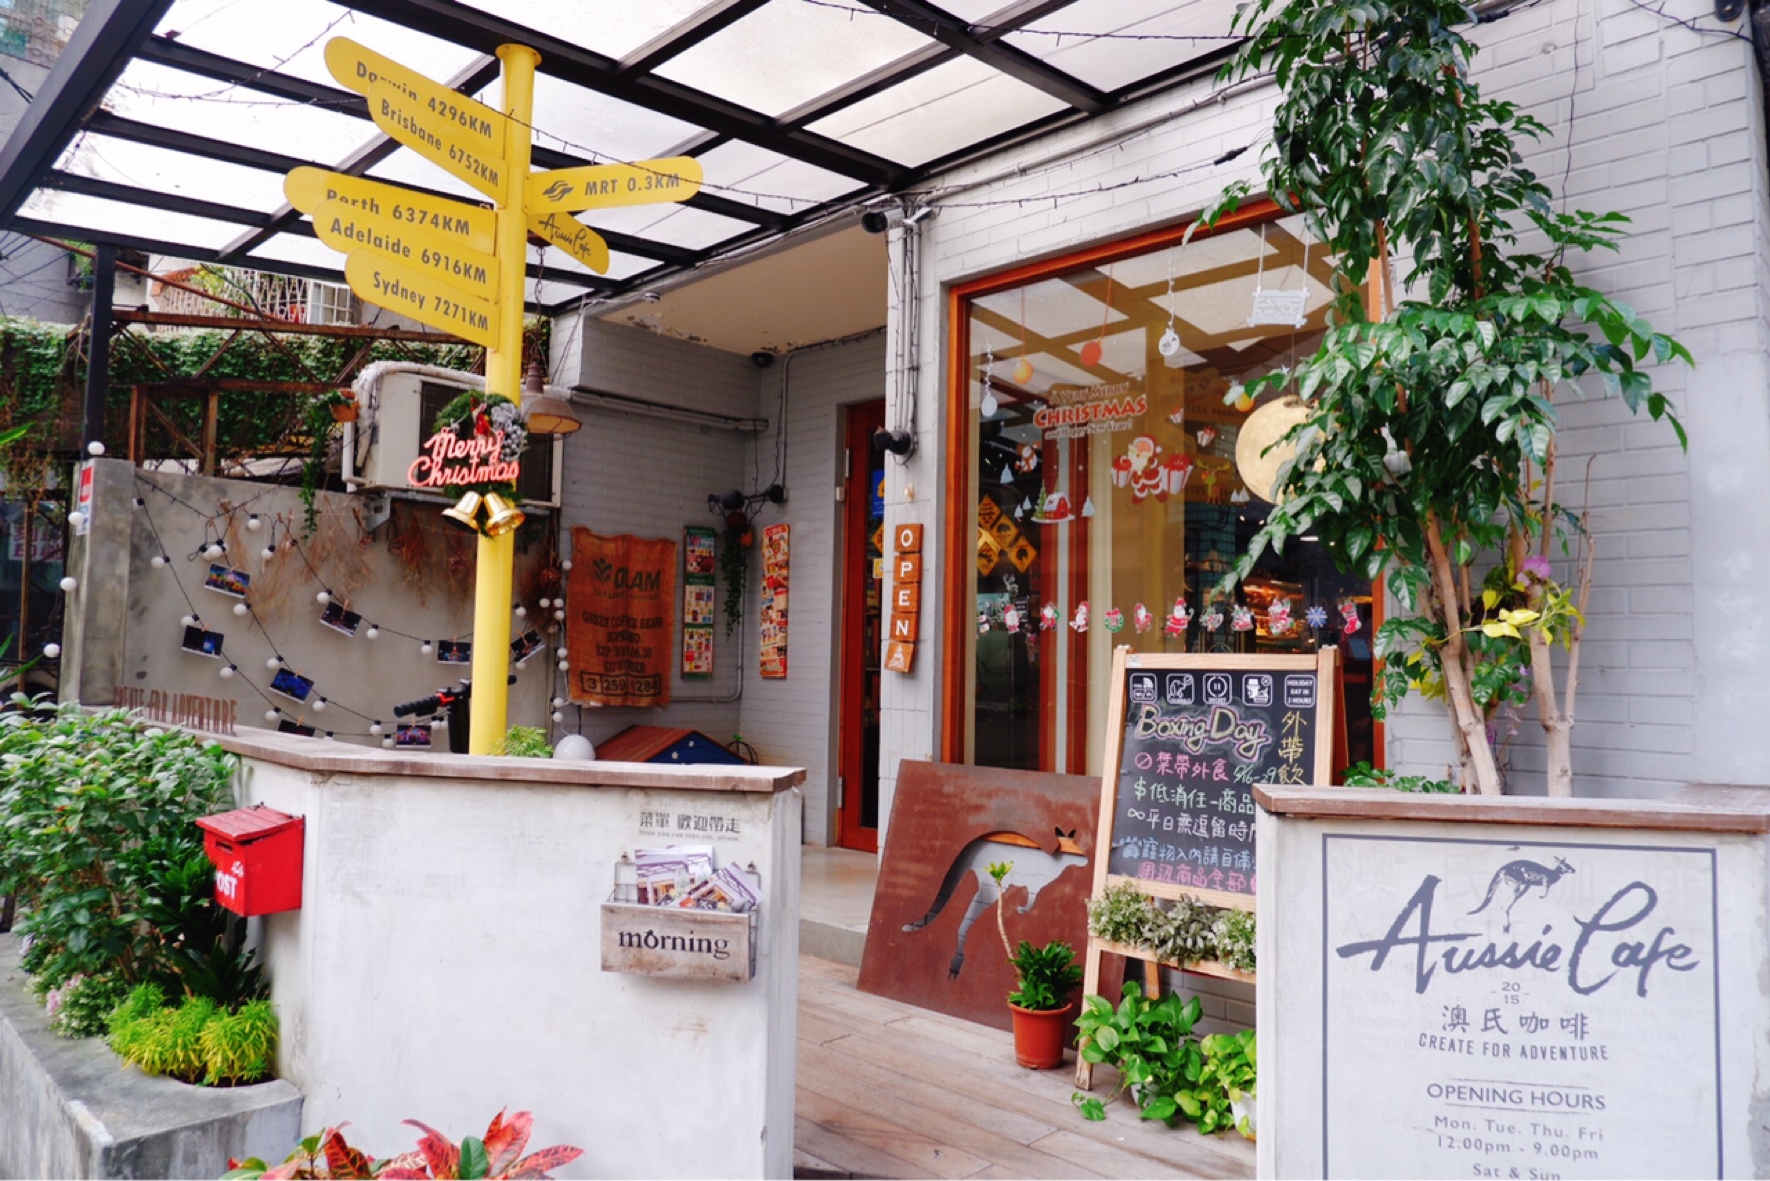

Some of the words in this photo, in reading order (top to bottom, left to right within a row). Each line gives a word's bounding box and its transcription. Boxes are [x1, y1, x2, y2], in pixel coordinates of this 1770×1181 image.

[356, 61, 418, 101] Dain
[428, 97, 493, 139] 4296KM
[381, 98, 442, 150] Brisbane
[449, 144, 499, 187] 6752KM
[584, 179, 618, 196] MRT
[627, 173, 680, 192] 0.3KM
[392, 204, 471, 236] 6374KM
[330, 217, 411, 258] Adelaide
[421, 248, 487, 285] 6916KM
[373, 271, 426, 310] Sydney
[434, 296, 489, 331] 7271KM
[1033, 393, 1148, 428] CHRISTMAS
[423, 426, 507, 463] Merry
[407, 455, 520, 488] Christmas
[614, 566, 662, 592] OLAM
[587, 677, 597, 690] 3
[603, 678, 627, 691] 259
[1135, 703, 1208, 755] Boxing
[1210, 705, 1272, 762] Day
[676, 813, 741, 834] 歡迎帶走
[1146, 808, 1257, 842] 平日無逗留時
[215, 870, 238, 900] OST
[618, 928, 731, 960] morning
[1336, 874, 1562, 995] Aussie
[1567, 880, 1701, 998] Cafe
[1501, 981, 1521, 992] 20
[1503, 994, 1521, 1005] 15
[1441, 1004, 1590, 1041] 澳氏咖啡
[1418, 1032, 1474, 1055] CREATE
[1482, 1042, 1511, 1058] FOR
[1519, 1044, 1609, 1061] ADVENTURE
[1426, 1083, 1524, 1105] OPENING
[1530, 1090, 1607, 1110] HOURS
[1434, 1115, 1477, 1131] Mon.
[1484, 1119, 1522, 1135] Tue.
[1529, 1122, 1570, 1138] Thu.
[1578, 1126, 1604, 1142] Fri
[1437, 1135, 1511, 1154] 12.00pm
[1532, 1142, 1599, 1162] 9.00pm
[1472, 1163, 1500, 1179] Sat
[1508, 1166, 1521, 1179] &
[1528, 1168, 1562, 1180] Sun
